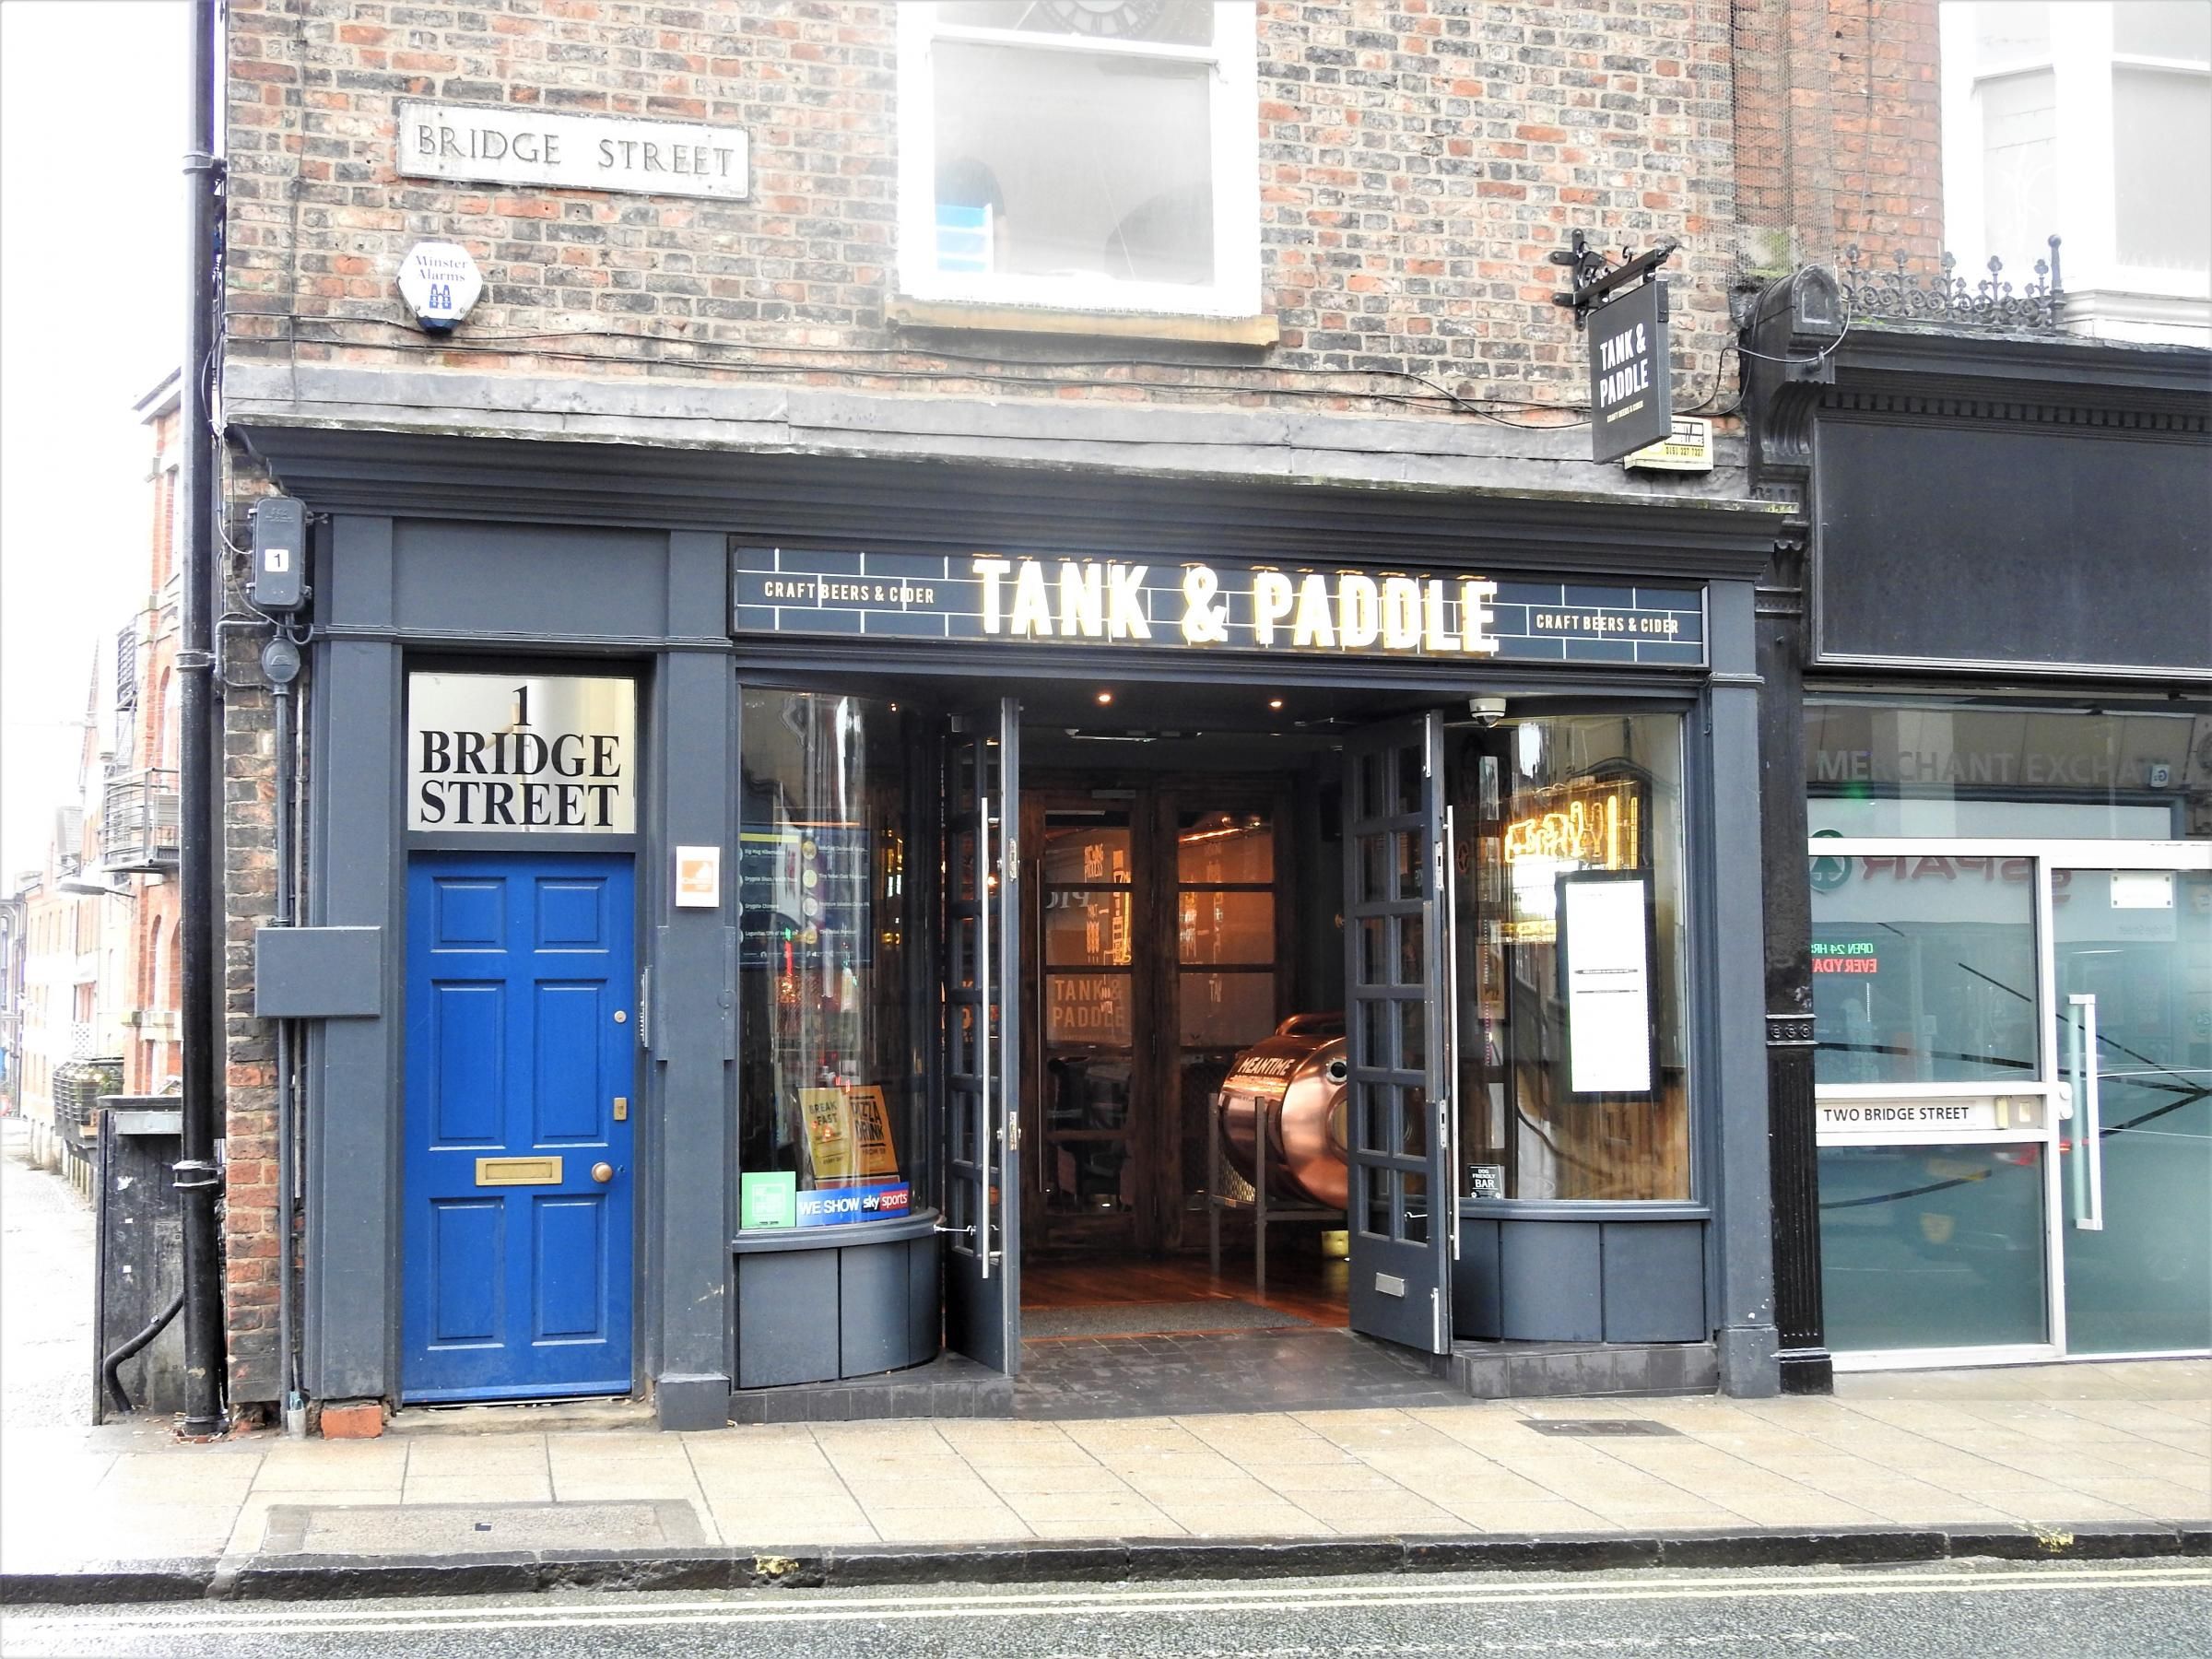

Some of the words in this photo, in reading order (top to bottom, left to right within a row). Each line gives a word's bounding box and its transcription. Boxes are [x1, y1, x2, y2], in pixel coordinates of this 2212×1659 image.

[418, 124, 561, 164] BRIDGE
[597, 138, 735, 177] STREET
[415, 255, 467, 268] Minster
[418, 268, 465, 281] Alarms
[1599, 329, 1635, 371] TANK
[1635, 323, 1647, 352] &
[1599, 359, 1649, 407] PADDLE
[274, 553, 281, 568] 1
[764, 581, 816, 599] CRAFT
[820, 582, 869, 601] BEERS
[875, 586, 885, 602] &
[889, 587, 935, 604] CIDER
[971, 558, 1152, 640] TANK
[1182, 564, 1229, 643] &
[1253, 571, 1500, 653] PADDLE
[1535, 614, 1580, 629] CRAFT
[1583, 616, 1625, 631] BEERS
[1628, 618, 1638, 632] &
[1641, 618, 1679, 634] CIDER
[512, 685, 532, 726] 1
[419, 730, 621, 778] BRIDGE
[1817, 749, 2014, 782] MERCHANT
[2027, 752, 2142, 782] EXCHA
[420, 779, 619, 827] STREET
[1054, 980, 1104, 1001] TANK
[1052, 1006, 1125, 1028] PADDLE
[1237, 1056, 1296, 1076] MEANTIME
[817, 1112, 838, 1125] FAST
[1823, 1108, 1860, 1122] TWO
[1865, 1107, 1915, 1122] BRIDGE
[1920, 1106, 1970, 1120] STREET
[854, 1121, 885, 1141] DRINK
[1475, 1179, 1495, 1188] BAR
[799, 1200, 821, 1216] WE
[823, 1197, 860, 1214] SHOW
[863, 1195, 879, 1214] sky
[881, 1192, 908, 1210] sports
